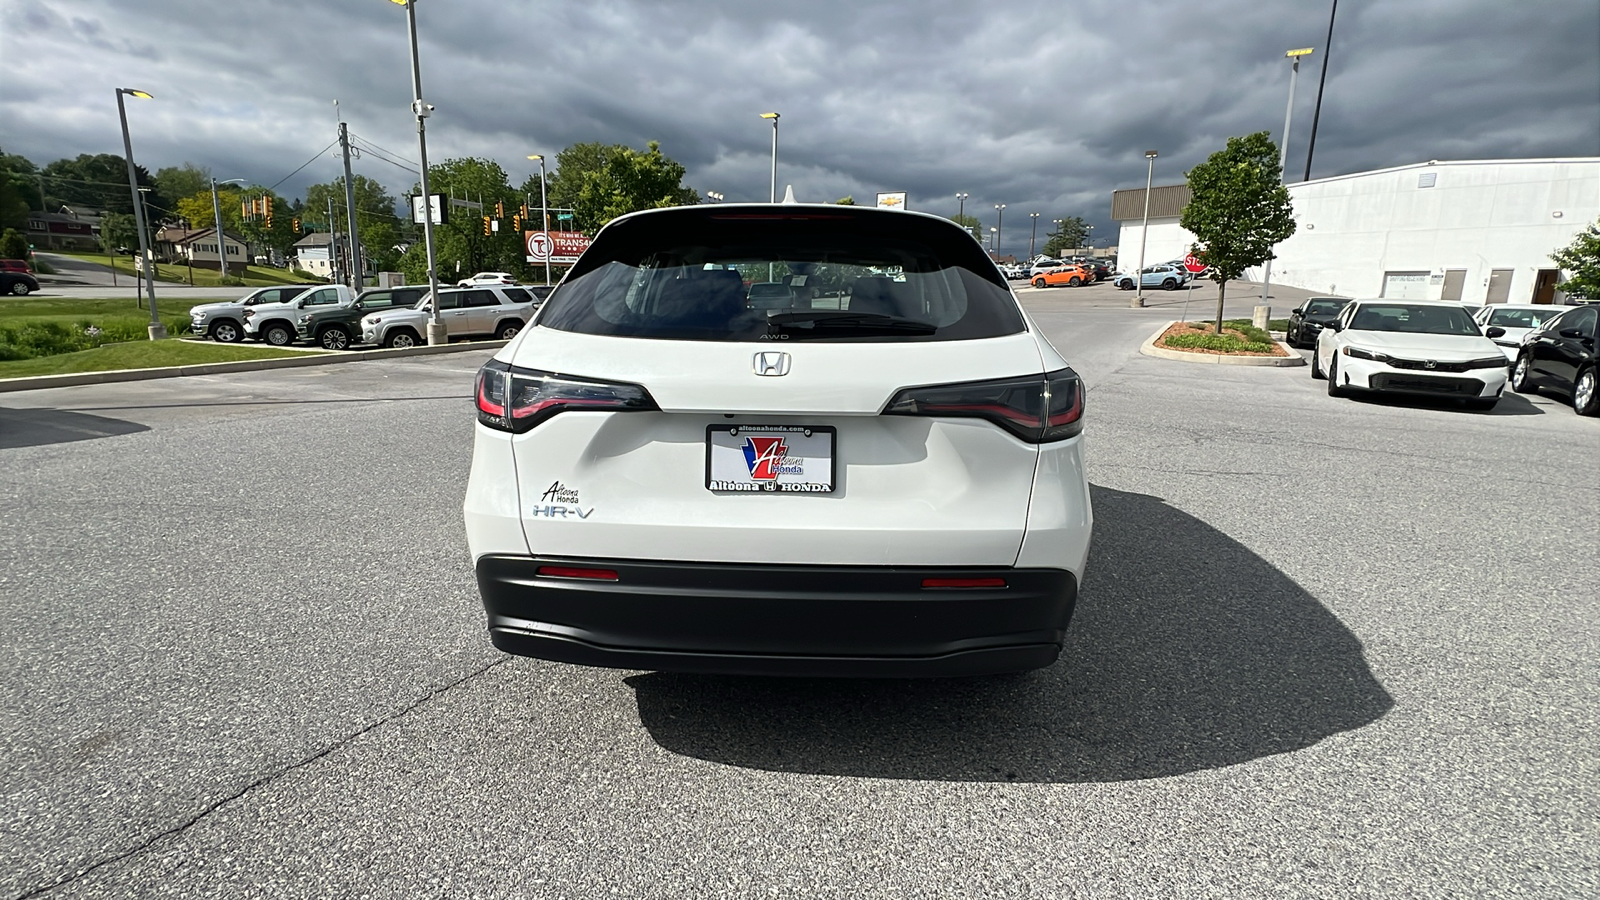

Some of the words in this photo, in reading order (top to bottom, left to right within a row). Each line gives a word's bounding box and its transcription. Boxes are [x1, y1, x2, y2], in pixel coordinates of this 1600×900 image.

[555, 238, 592, 247] TRANS4
[772, 465, 803, 474] Honda
[709, 481, 760, 491] Altoona
[781, 483, 832, 492] HONDA
[533, 504, 594, 519] HR-V
